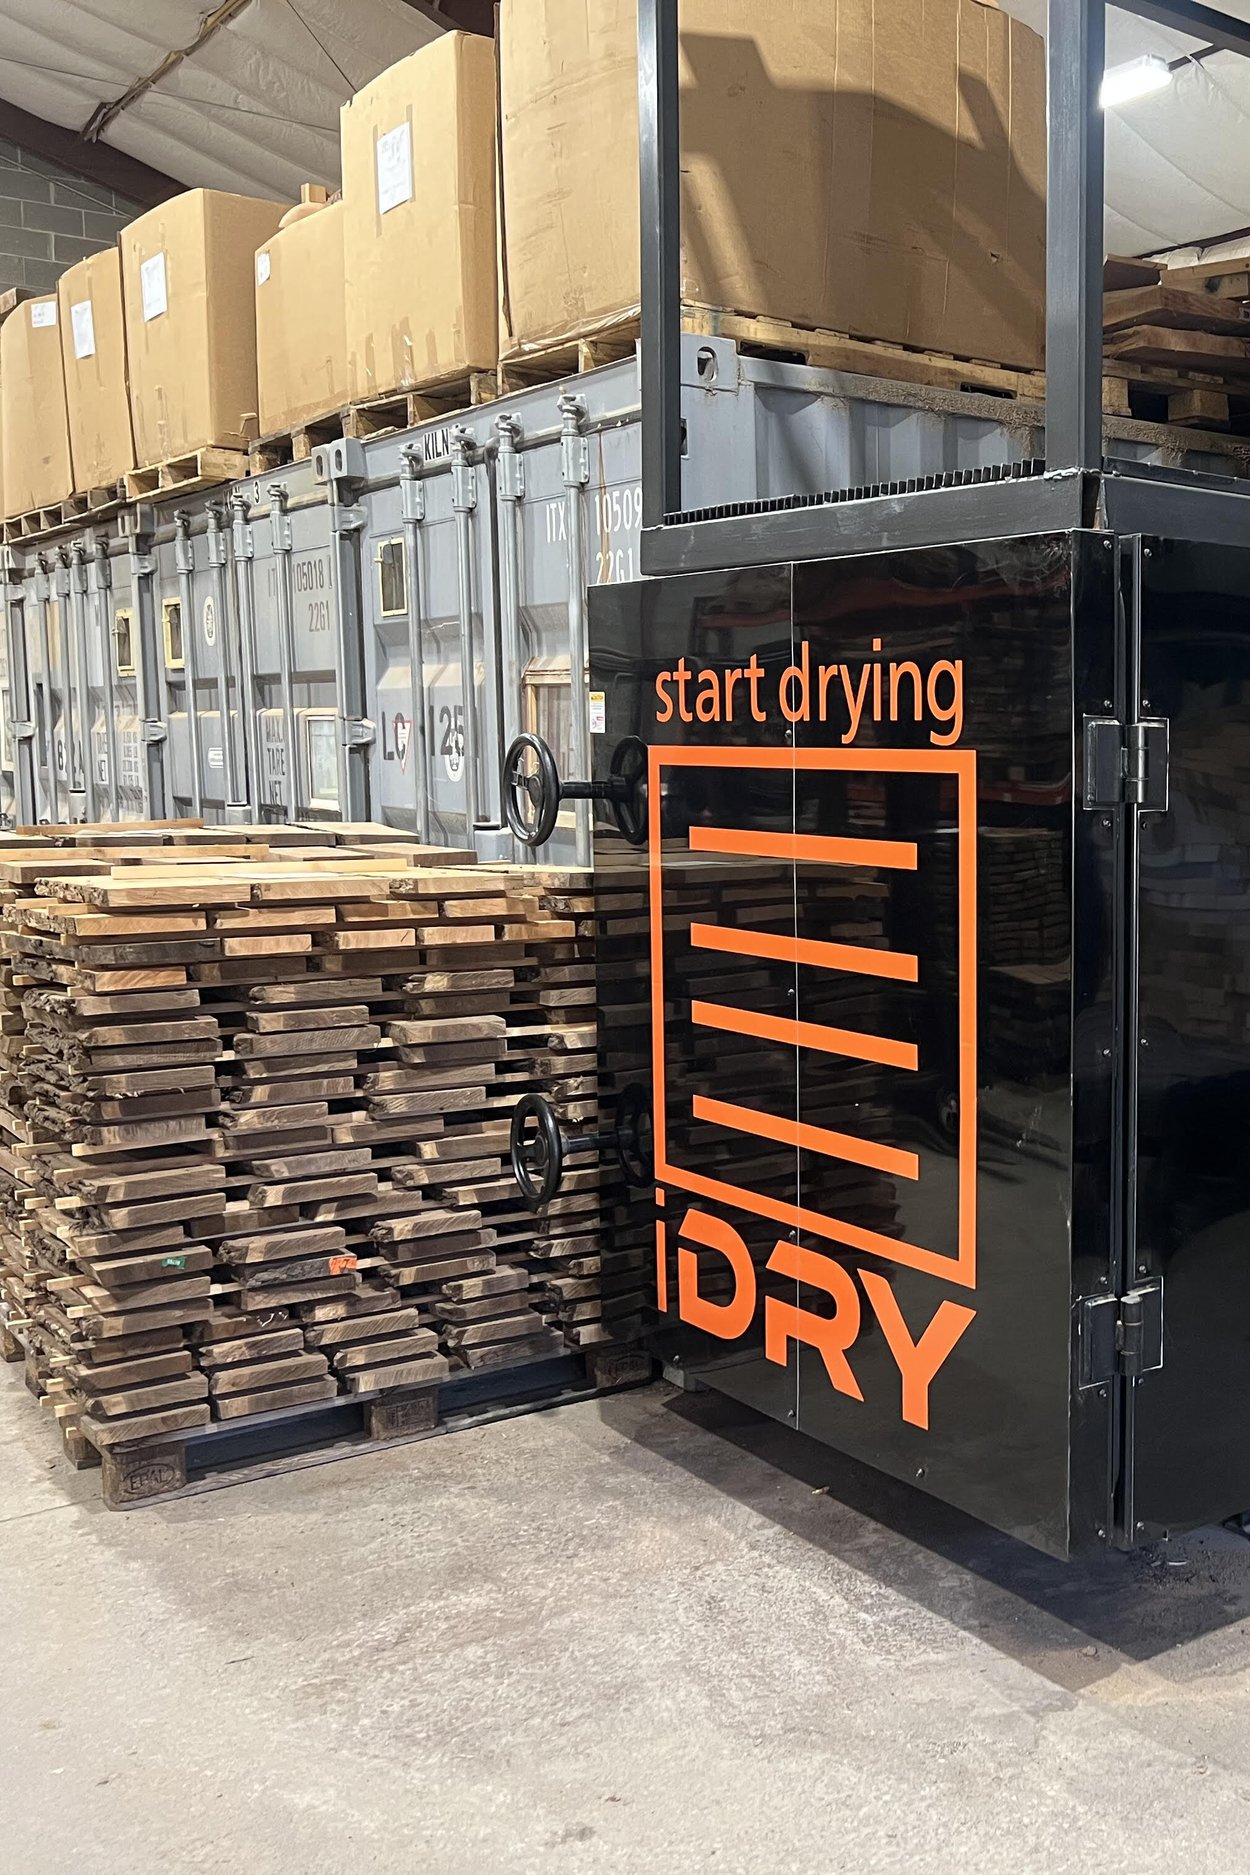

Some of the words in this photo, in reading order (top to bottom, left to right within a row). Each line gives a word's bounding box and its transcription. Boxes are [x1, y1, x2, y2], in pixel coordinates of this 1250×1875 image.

[424, 428, 450, 461] KILN
[254, 481, 260, 503] 3
[546, 501, 567, 543] ITX
[595, 487, 642, 536] 10509
[596, 548, 634, 584] 22G1
[308, 600, 330, 633] 22G1
[655, 656, 767, 723] start
[779, 638, 963, 746] drying
[655, 1186, 977, 1431] iDRY
